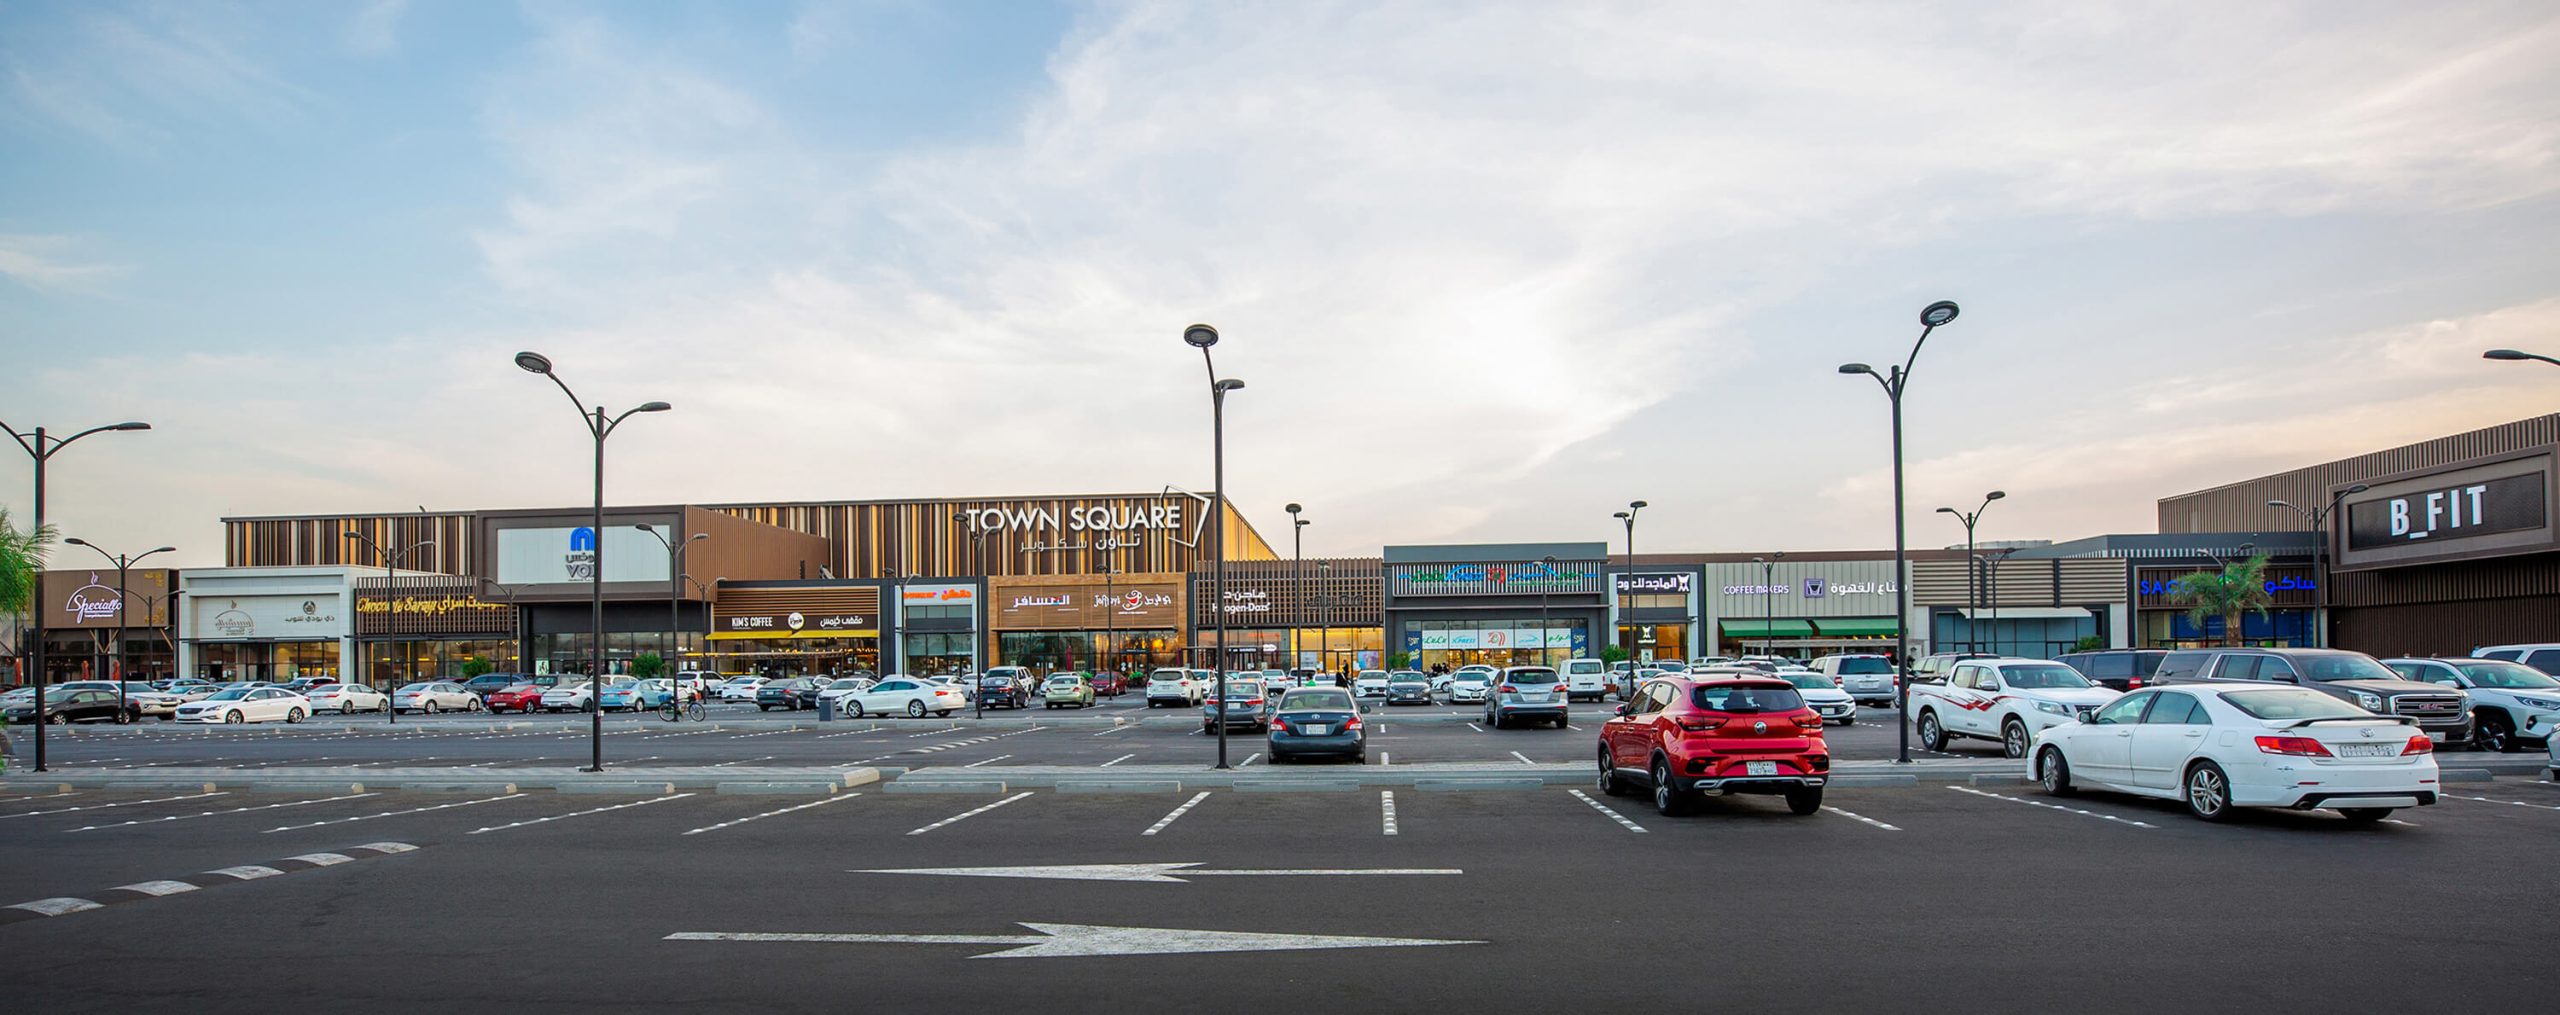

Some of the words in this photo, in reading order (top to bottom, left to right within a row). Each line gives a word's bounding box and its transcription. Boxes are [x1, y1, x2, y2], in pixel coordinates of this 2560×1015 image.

[966, 507, 1060, 533] TOWN
[1069, 505, 1181, 531] SQUARE
[2390, 485, 2487, 539] B_FIT
[1020, 537, 1088, 553] سكوير
[1095, 533, 1141, 551] تاون
[1646, 577, 1677, 591] الماجد
[1723, 585, 1755, 595] COFFEE
[1830, 582, 1875, 596] القهوة
[731, 617, 749, 627] KIM'S
[750, 616, 773, 627] COFFEE
